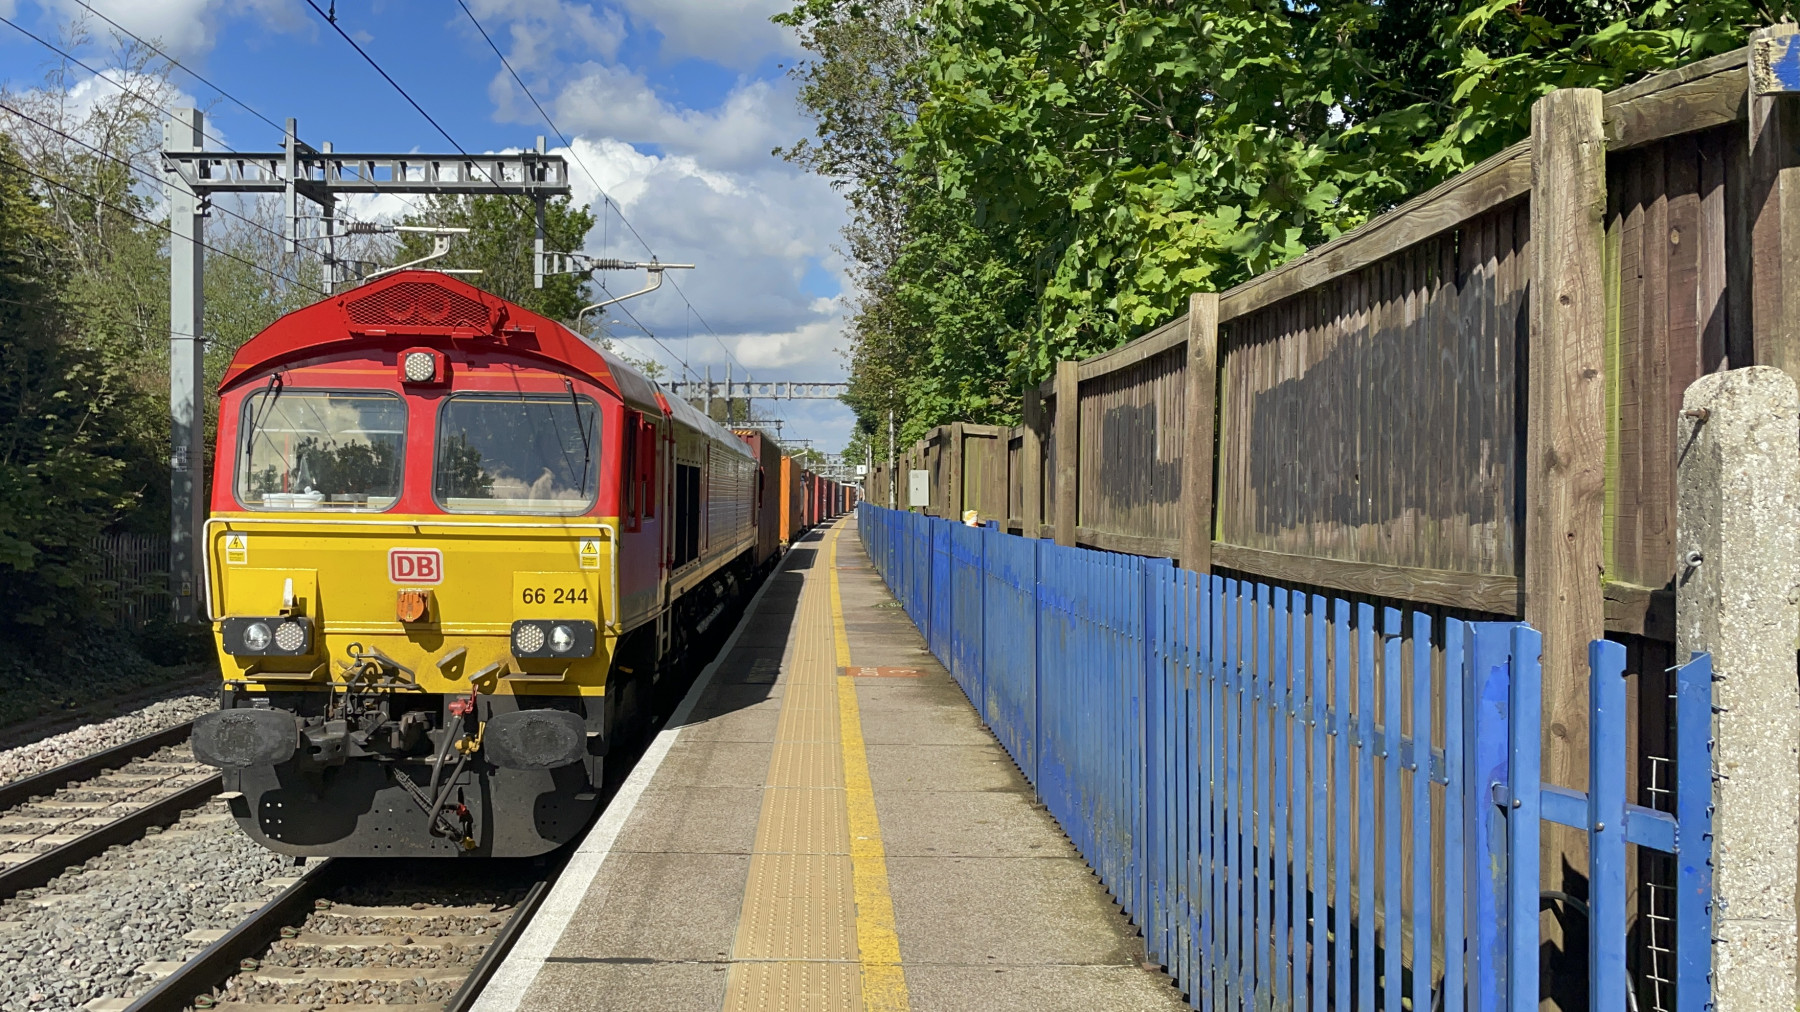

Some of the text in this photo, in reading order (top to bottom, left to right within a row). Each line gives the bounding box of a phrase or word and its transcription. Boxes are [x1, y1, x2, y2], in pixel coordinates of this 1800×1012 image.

[397, 556, 434, 577] DB
[522, 587, 589, 604] 66 244
